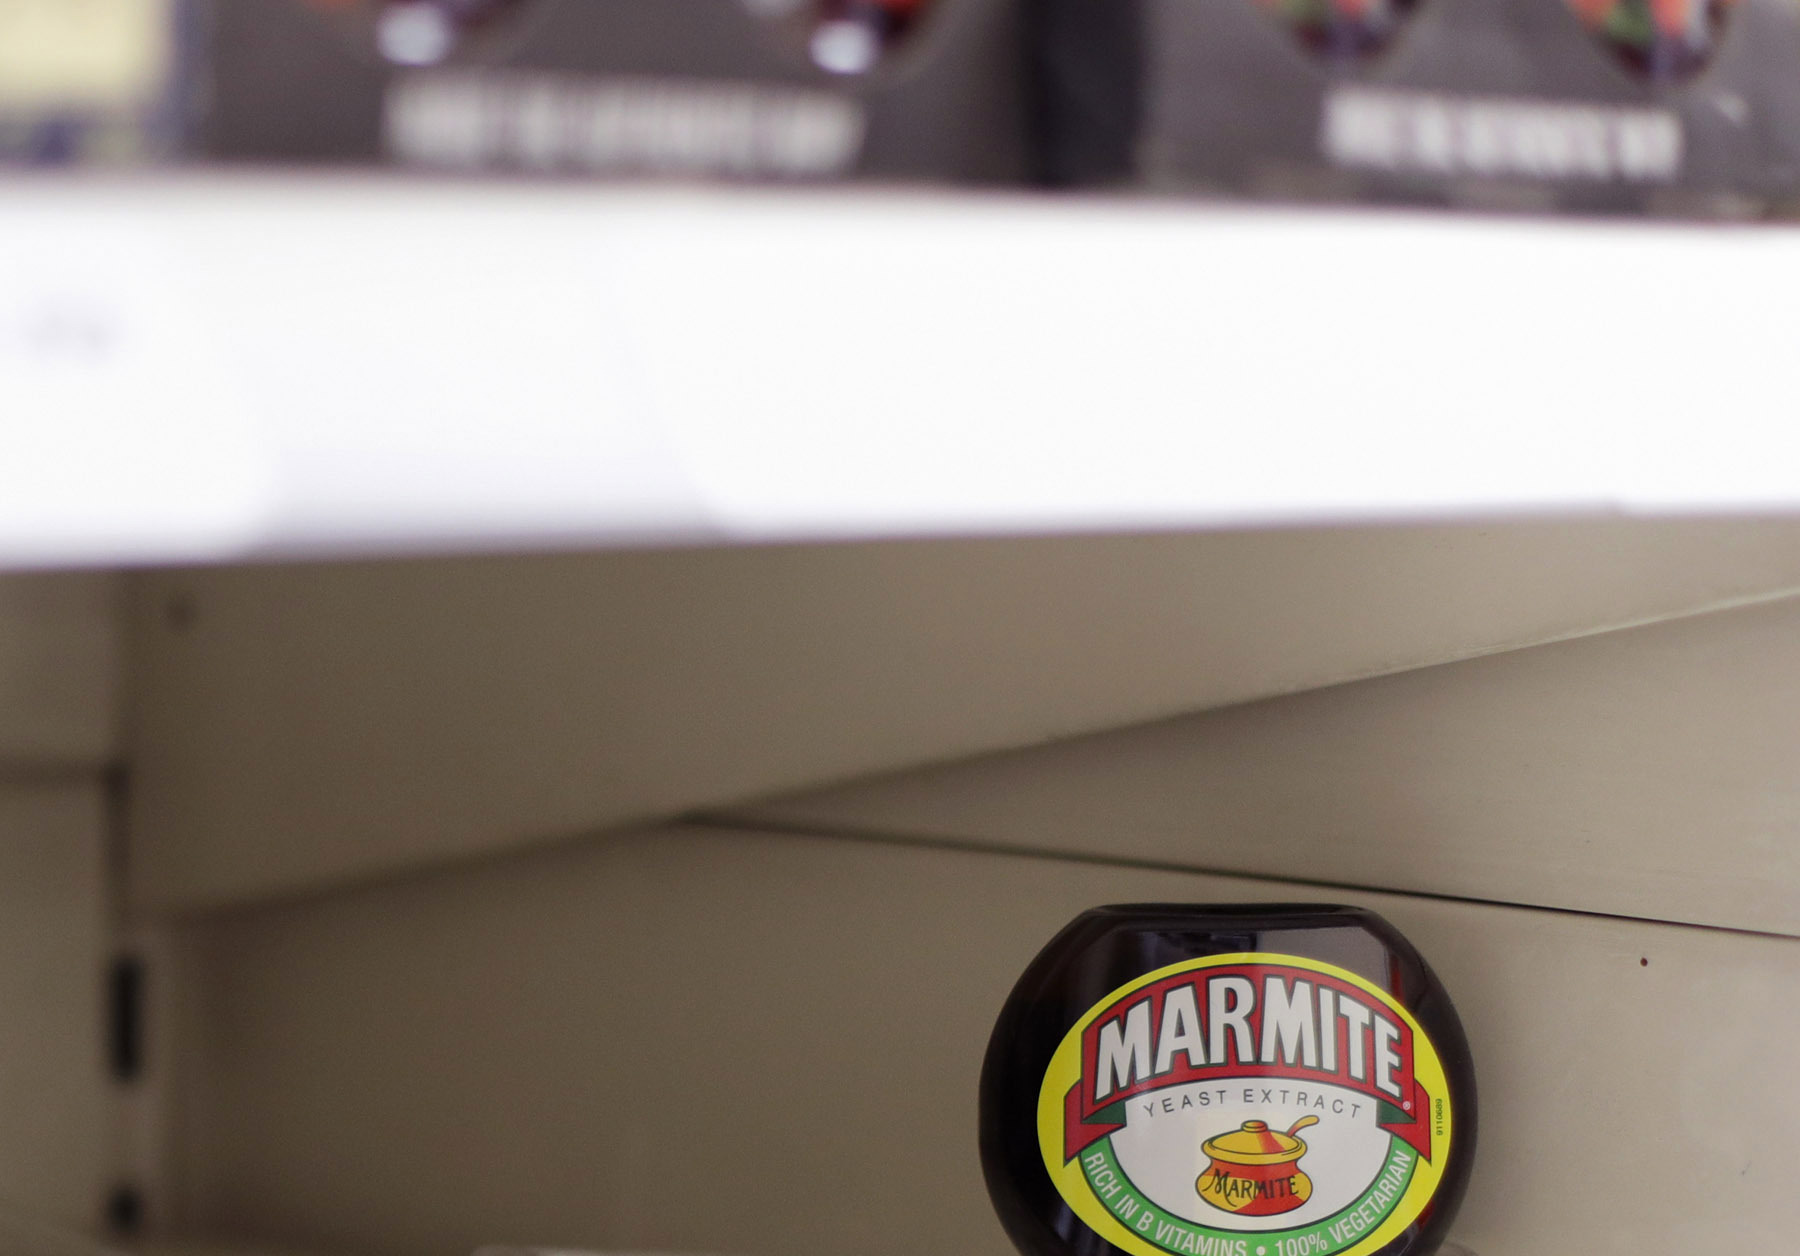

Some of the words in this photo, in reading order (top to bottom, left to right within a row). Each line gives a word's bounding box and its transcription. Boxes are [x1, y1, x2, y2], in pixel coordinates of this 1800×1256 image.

[1093, 975, 1403, 1103] MARMITE
[1143, 1089, 1227, 1118] YEAST
[1243, 1088, 1362, 1119] EXTRACT
[1084, 1151, 1122, 1200] RICH
[1114, 1193, 1140, 1220] IN
[1136, 1210, 1155, 1233] B
[1327, 1149, 1413, 1245] VEGETARIAN
[1201, 1168, 1300, 1207] MARMITE
